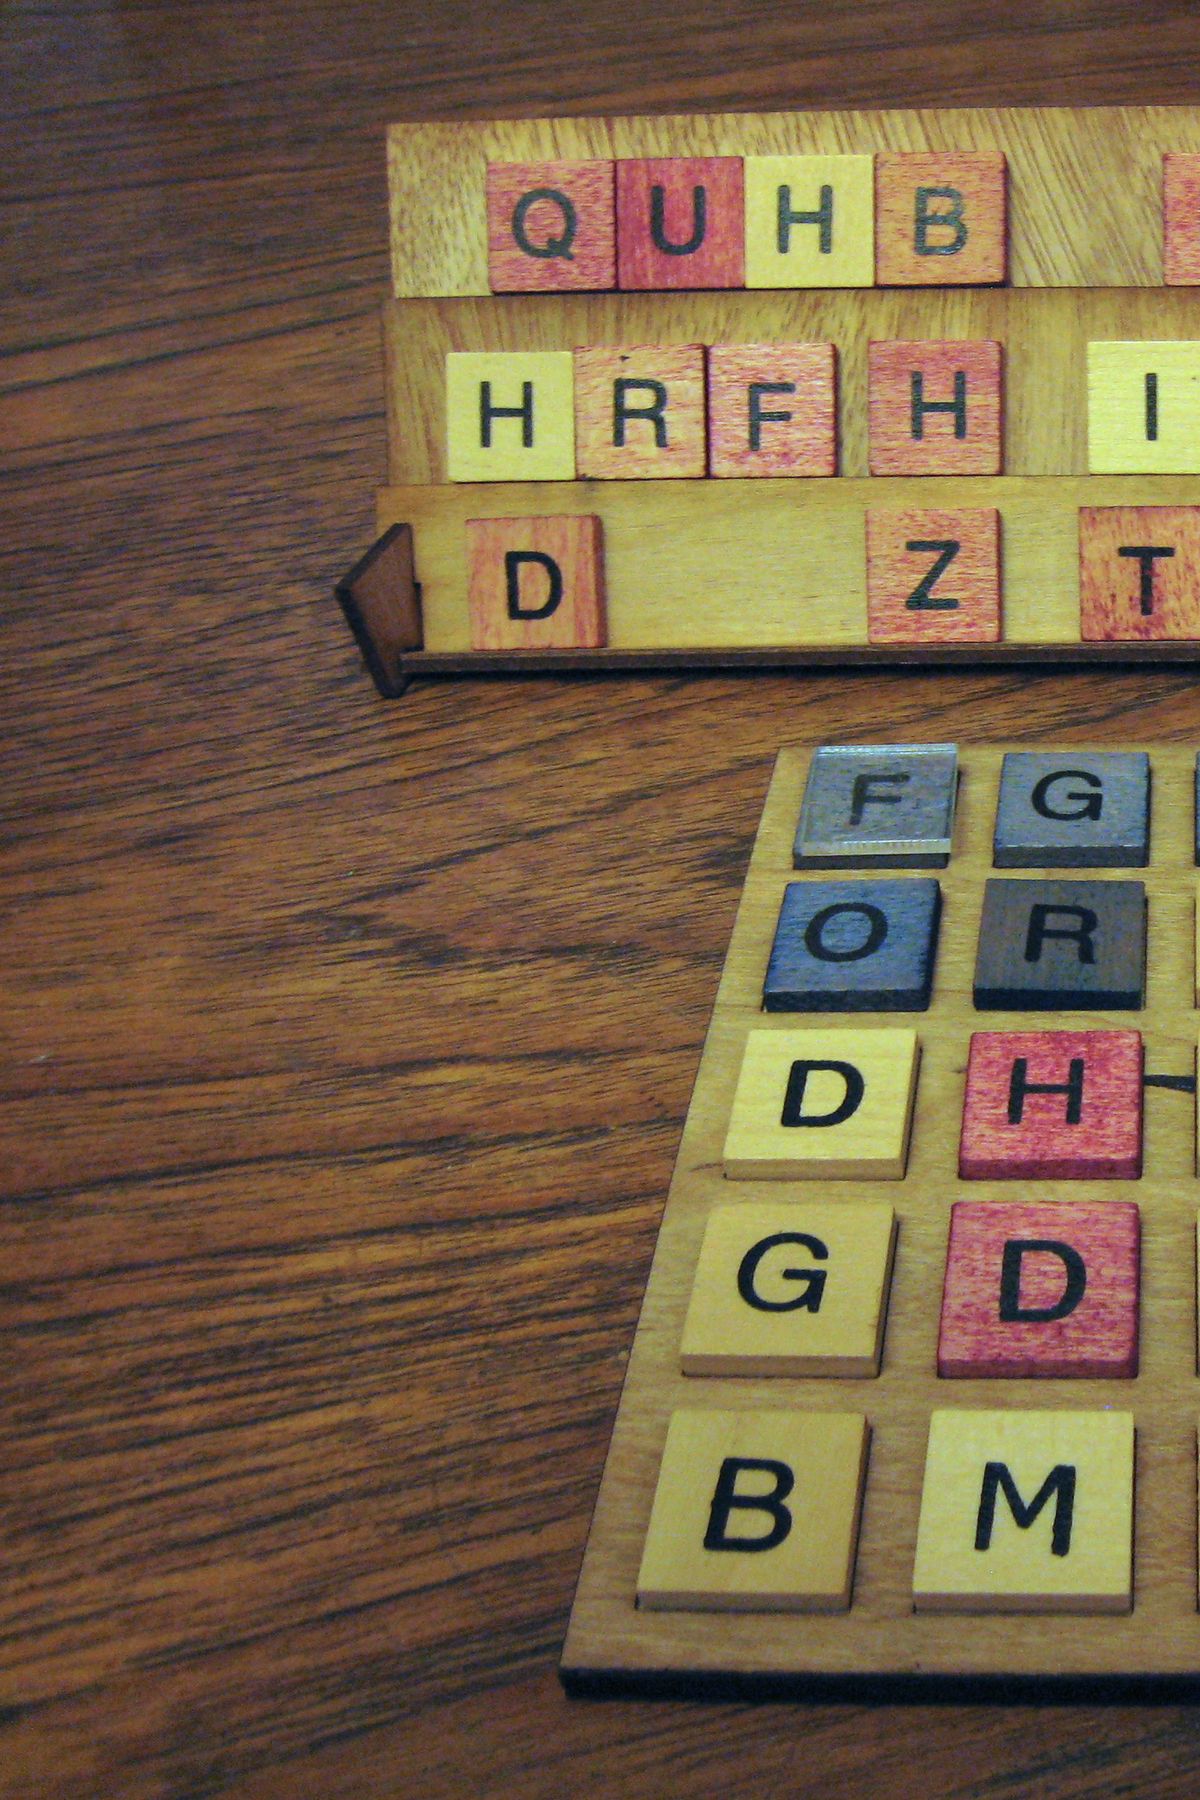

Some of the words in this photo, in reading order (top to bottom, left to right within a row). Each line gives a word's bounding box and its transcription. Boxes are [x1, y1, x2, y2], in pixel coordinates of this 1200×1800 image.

[505, 551, 563, 621] D
[904, 540, 960, 611] Z
[1118, 545, 1175, 617] T
[849, 774, 910, 826] F
[1031, 770, 1103, 821] G
[804, 902, 889, 962] O
[1024, 903, 1098, 964] R
[780, 1060, 865, 1128] D
[1008, 1058, 1085, 1125] H
[737, 1232, 829, 1313] G
[999, 1239, 1086, 1323] D
[703, 1458, 794, 1553] B
[974, 1463, 1076, 1557] M
